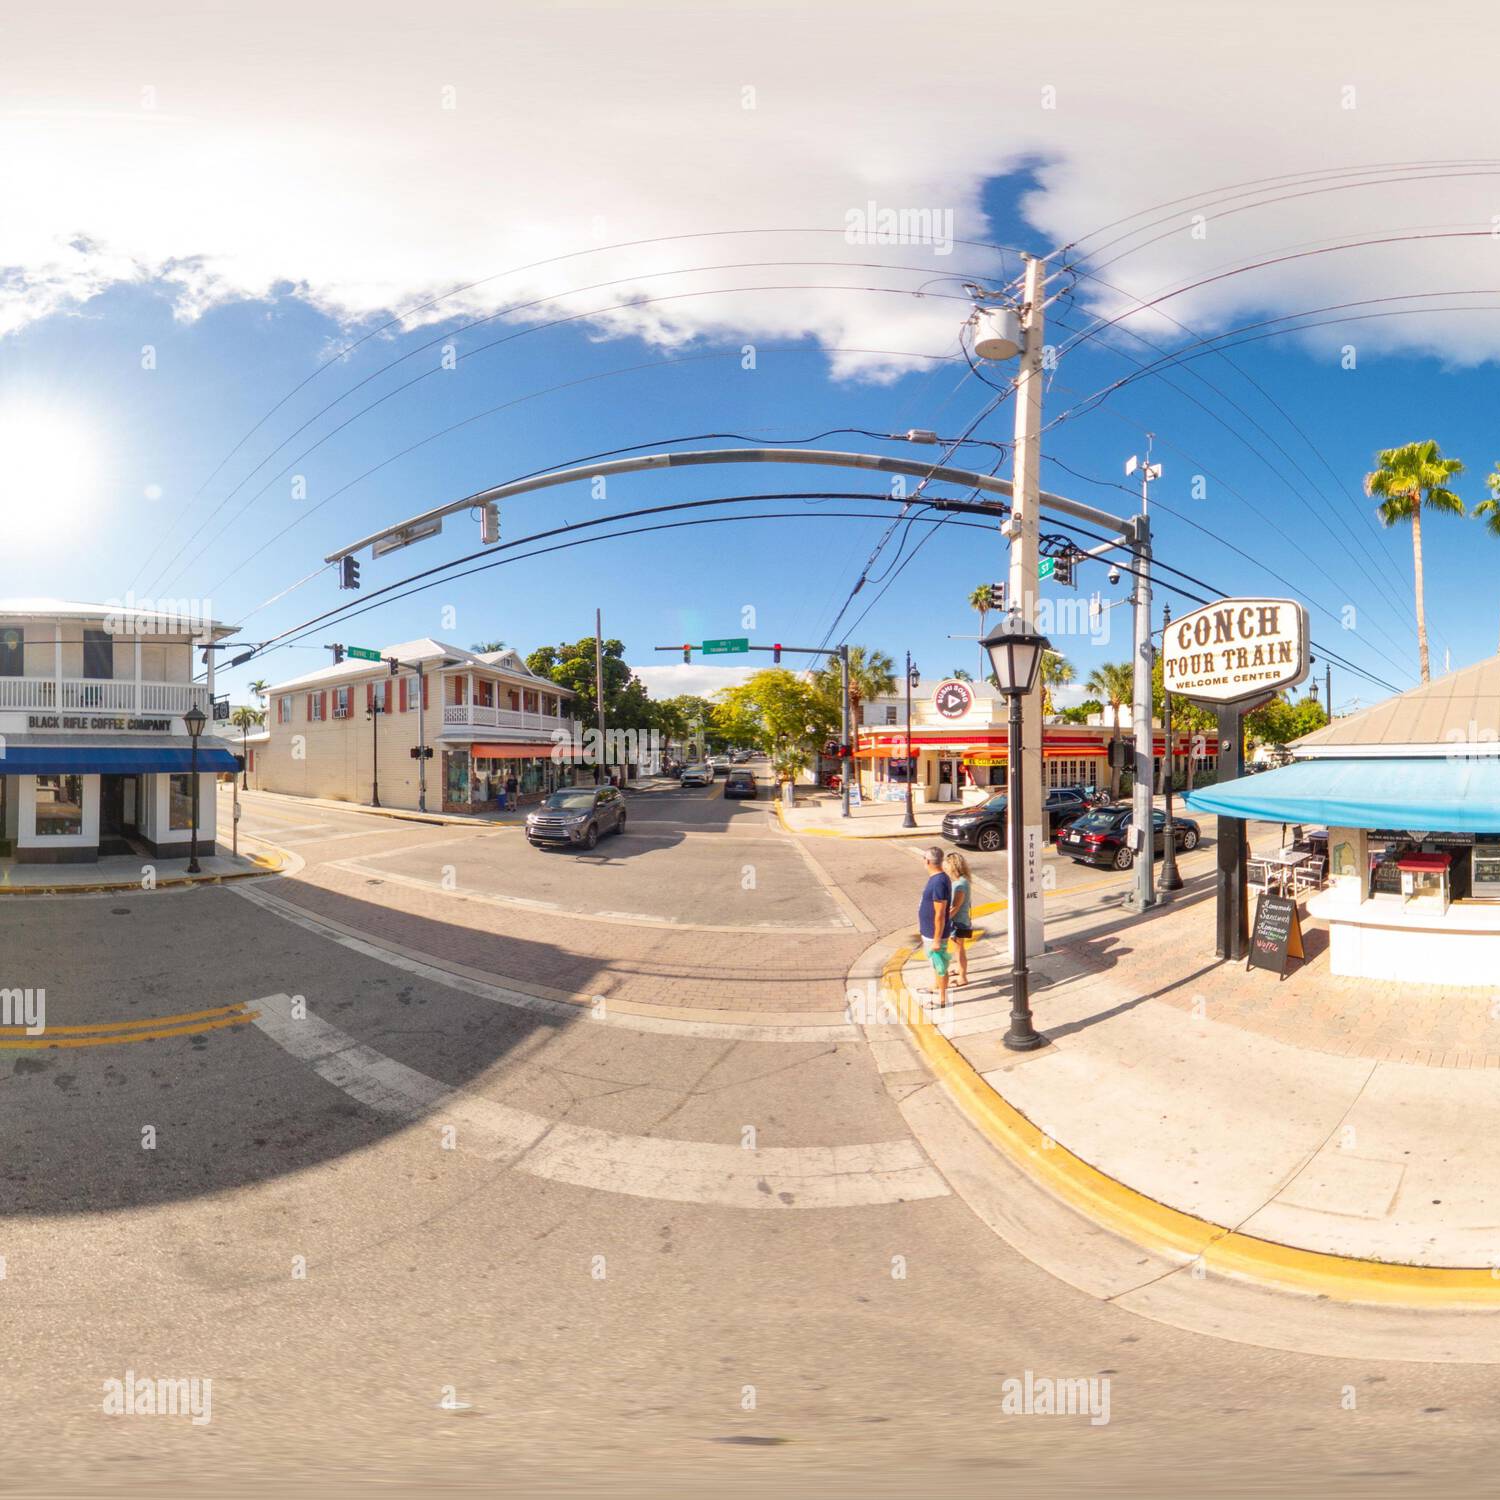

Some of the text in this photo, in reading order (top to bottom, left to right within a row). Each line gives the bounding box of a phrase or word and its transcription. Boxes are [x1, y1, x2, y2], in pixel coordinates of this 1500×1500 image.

[1177, 606, 1280, 650] CONCH
[1166, 640, 1293, 678] TOUR TRAIN
[1176, 670, 1281, 689] WELCOME CENTER
[28, 716, 171, 731] BLACK RIFLE COFFEE COMPANY
